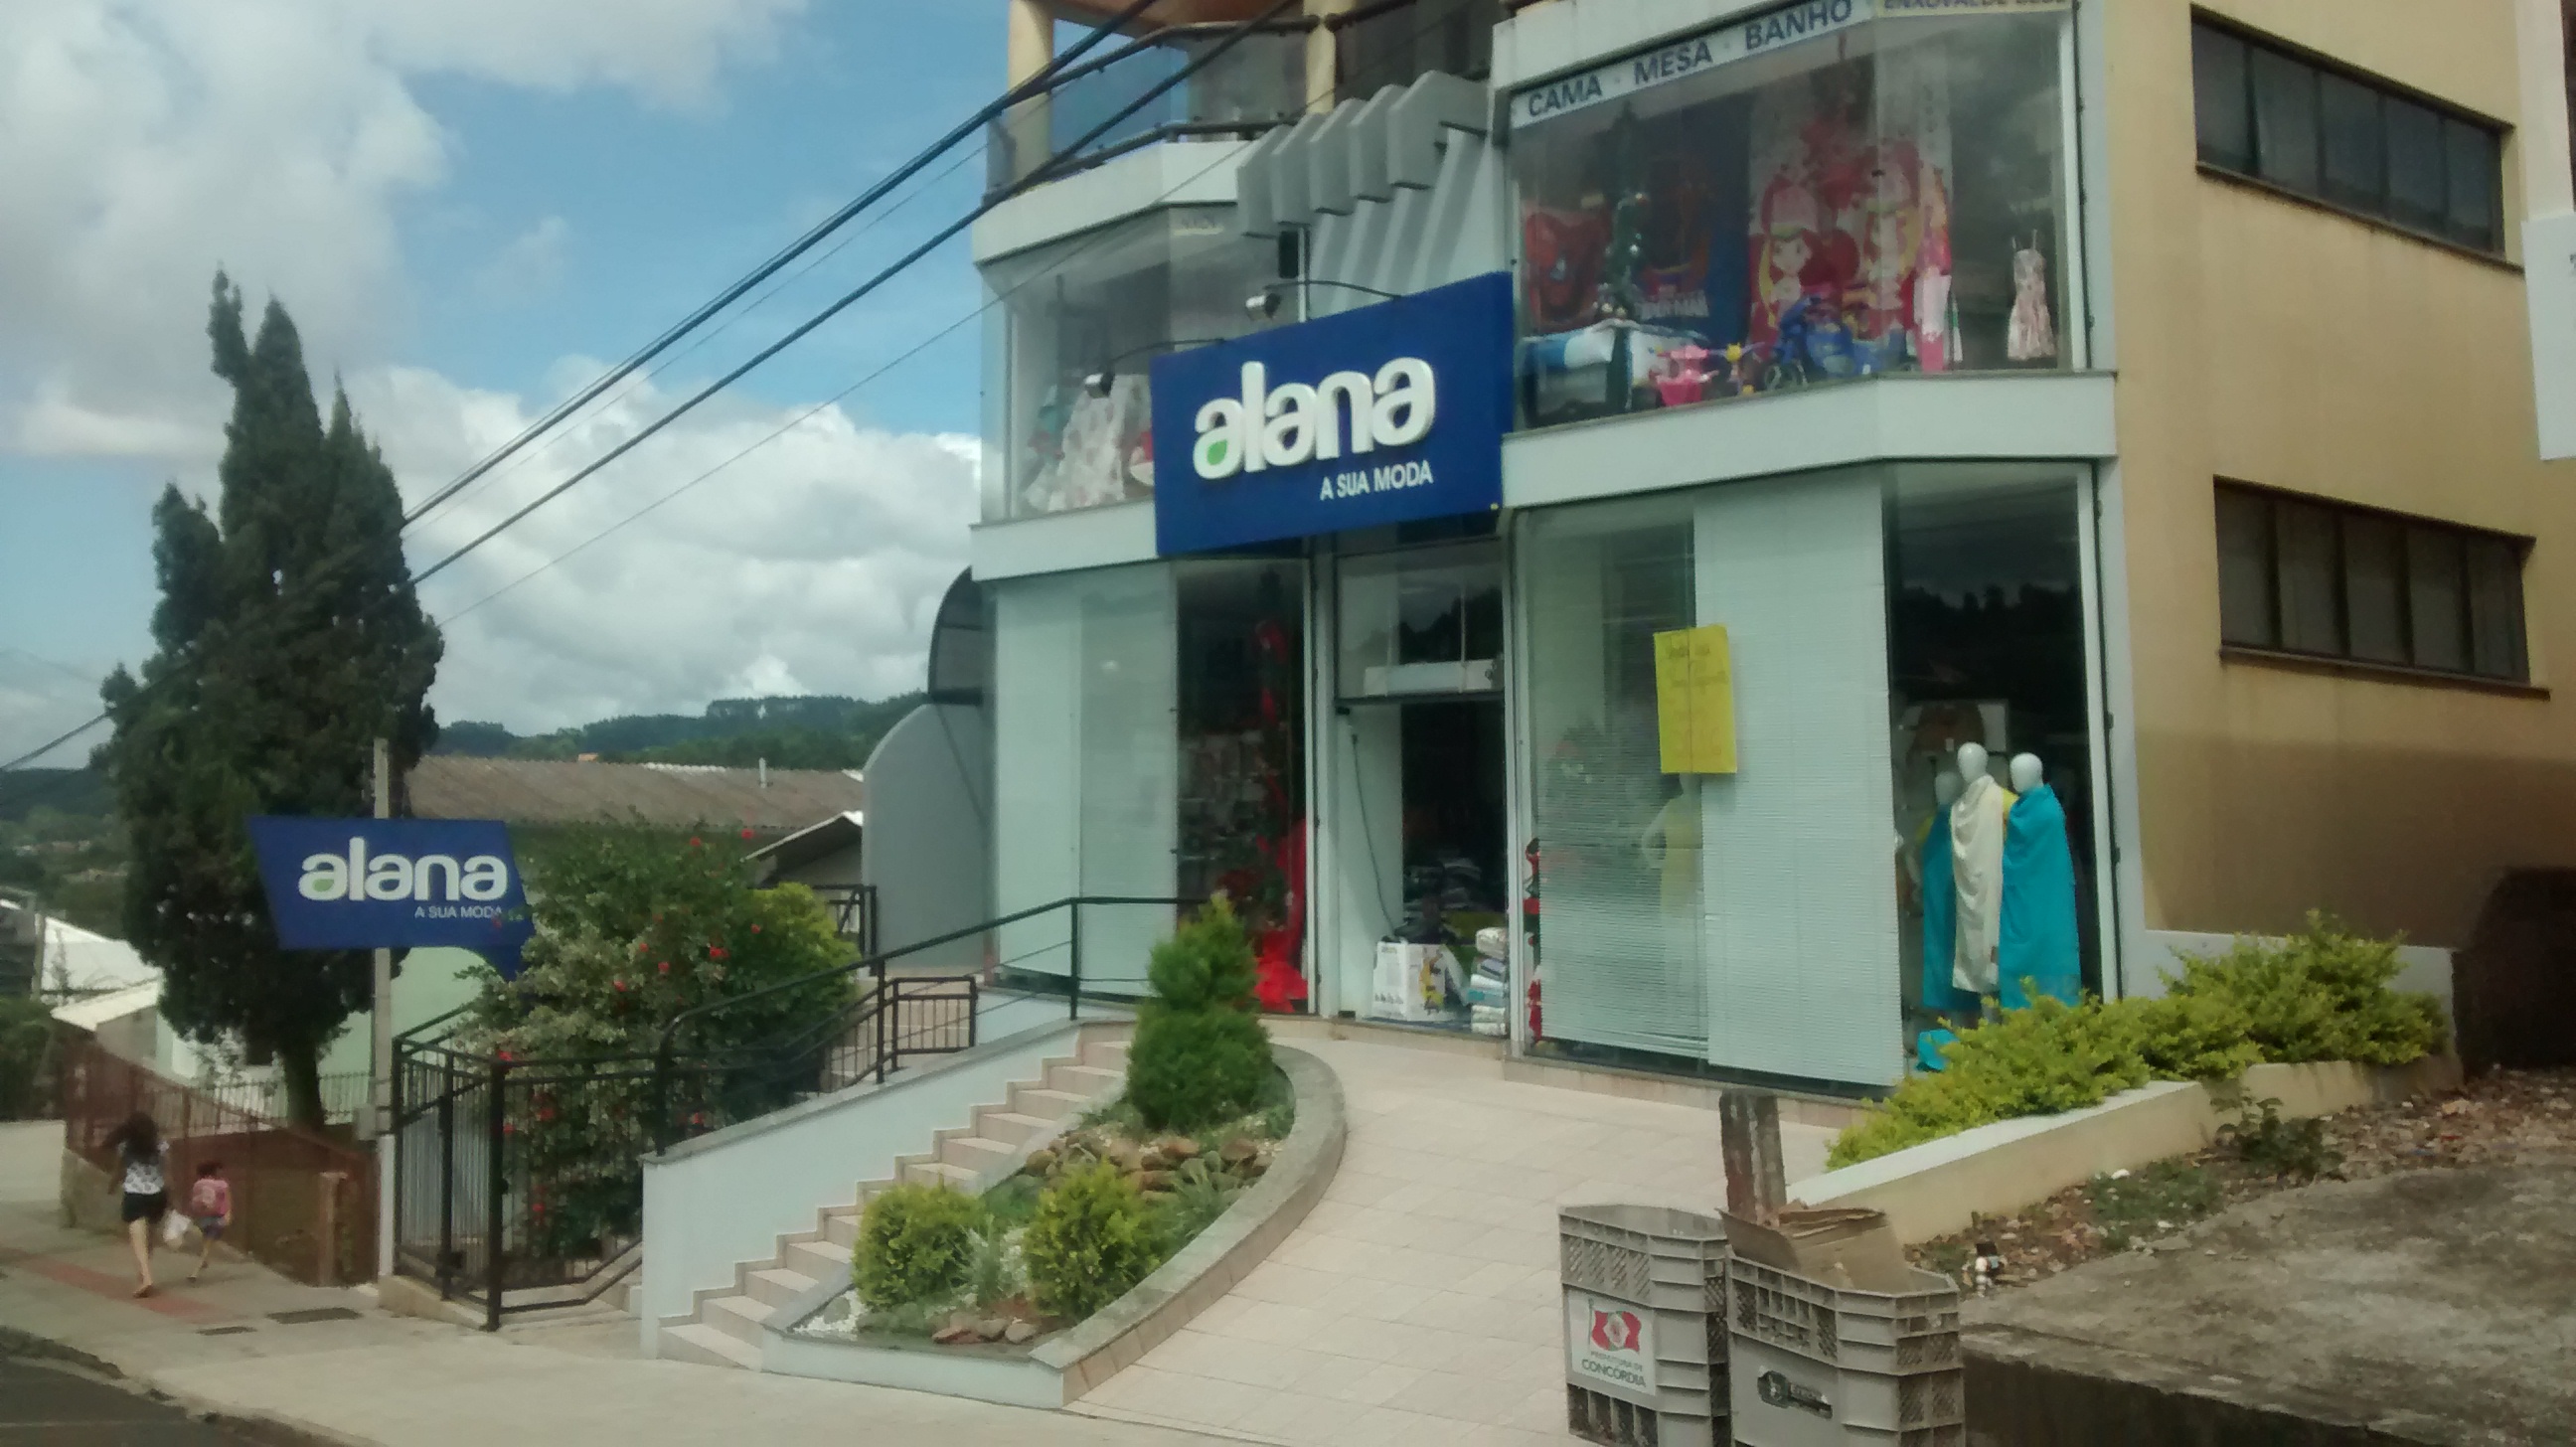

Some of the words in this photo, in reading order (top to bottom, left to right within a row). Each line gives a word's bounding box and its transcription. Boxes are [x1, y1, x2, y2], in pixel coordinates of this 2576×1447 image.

[1528, 74, 1603, 117] CAMA
[1634, 42, 1713, 84] MESA
[1744, 0, 1852, 50] BANHO
[1193, 356, 1436, 481] alana
[1319, 476, 1334, 501] A
[1337, 470, 1370, 498] SUA
[1373, 459, 1434, 493] MODA
[298, 836, 508, 901] alana
[414, 905, 425, 918] A
[428, 905, 457, 919] SUA
[460, 904, 502, 918] MODA
[1582, 1359, 1647, 1388] CONCORDIA
